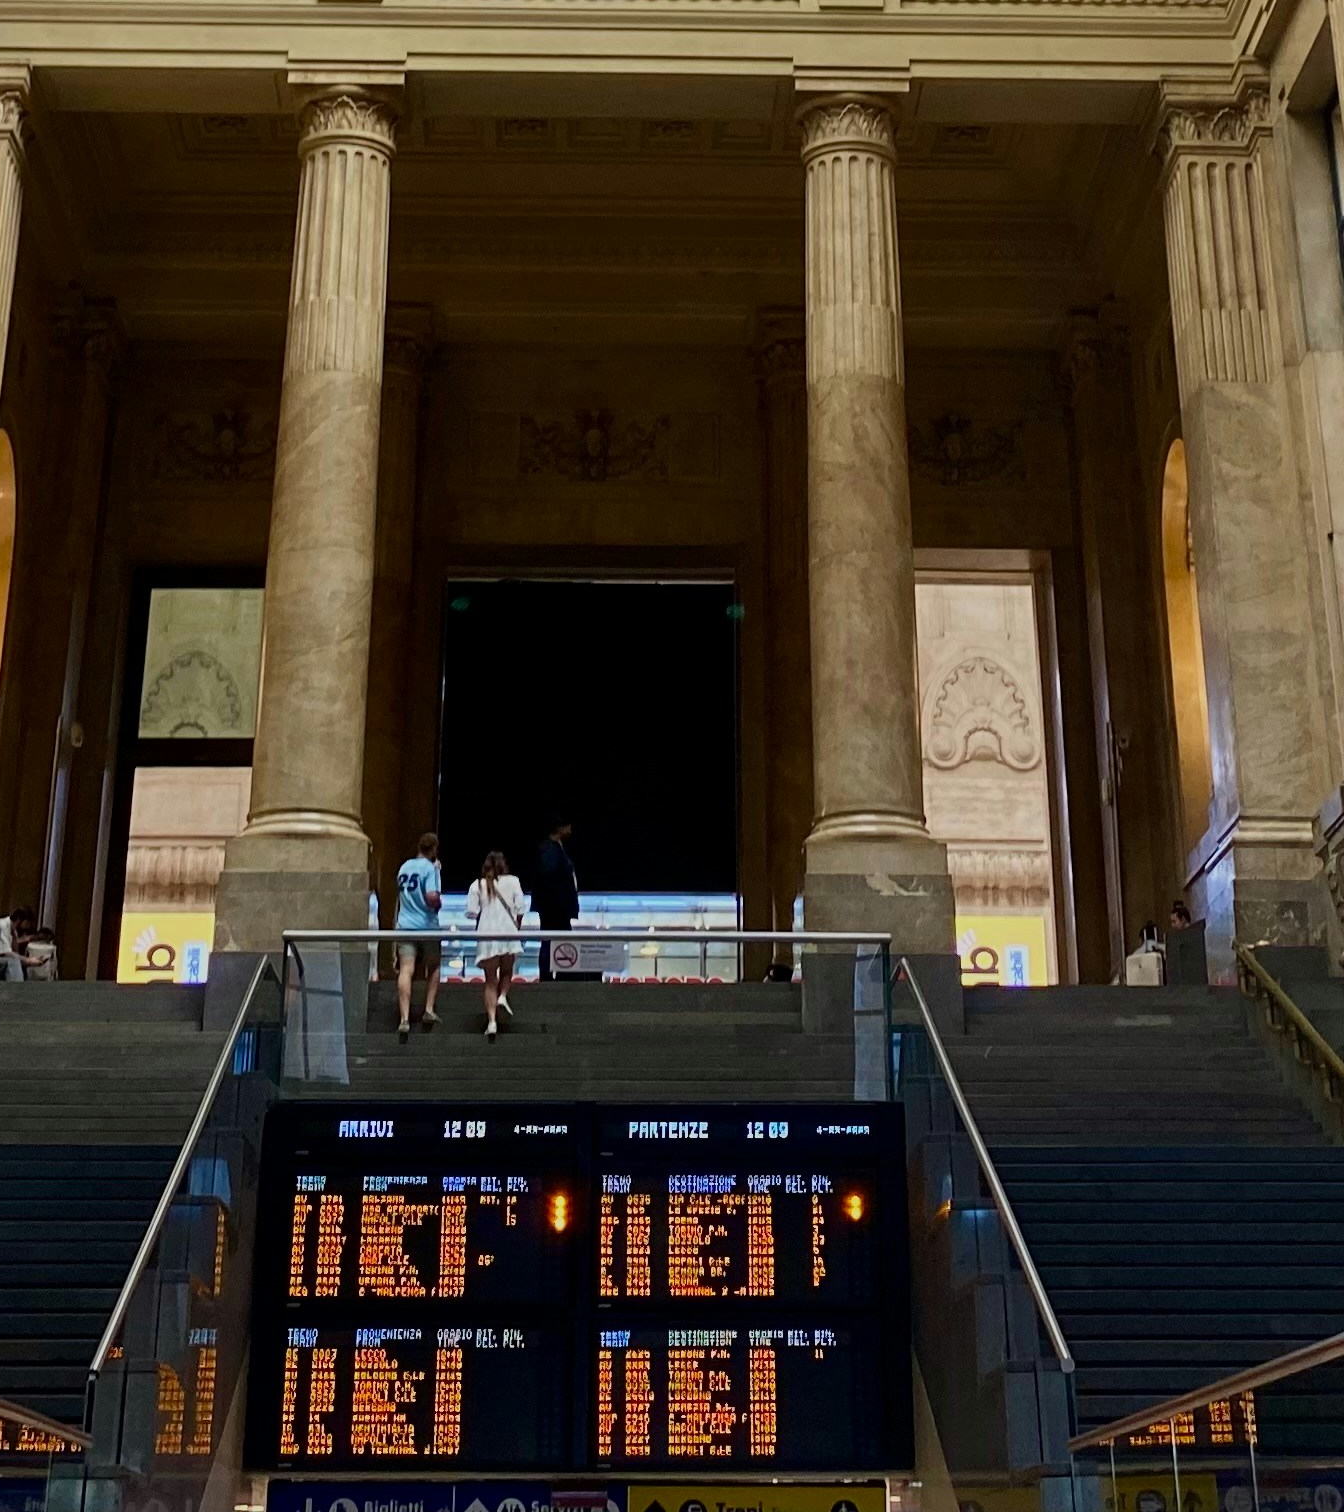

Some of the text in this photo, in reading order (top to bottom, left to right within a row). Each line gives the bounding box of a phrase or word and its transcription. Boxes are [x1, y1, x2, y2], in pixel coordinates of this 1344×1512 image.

[339, 1121, 393, 1137] ARRIVI
[629, 1122, 708, 1138] PARTENZE
[365, 1500, 423, 1512] Biglietti
